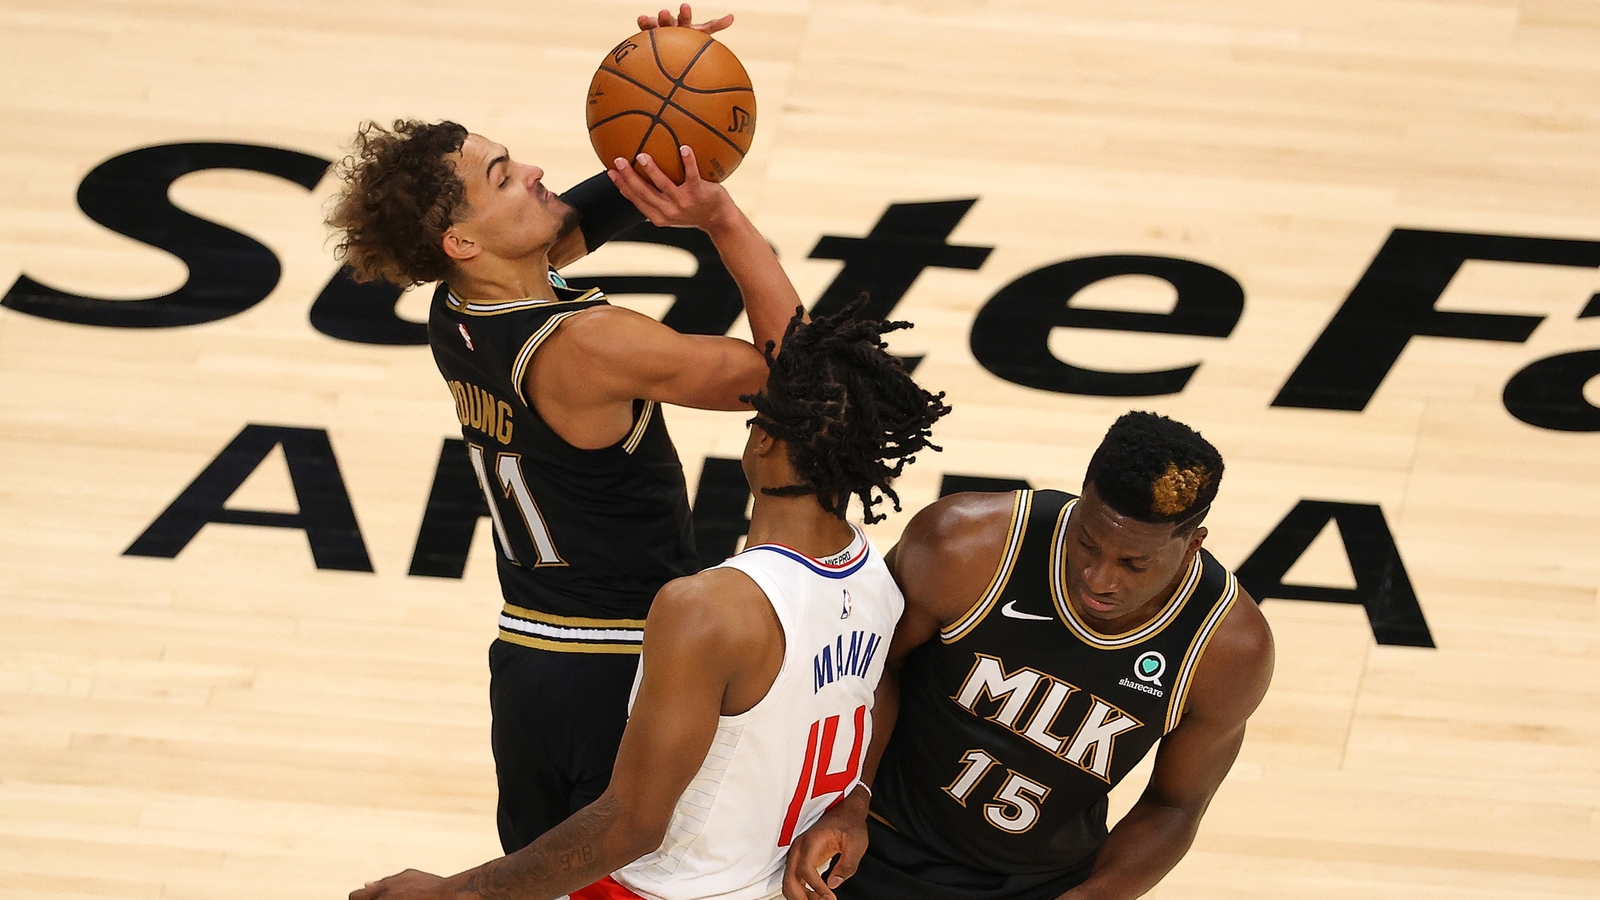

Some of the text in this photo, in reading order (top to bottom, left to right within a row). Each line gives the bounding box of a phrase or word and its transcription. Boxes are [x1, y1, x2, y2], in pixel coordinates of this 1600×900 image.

[814, 631, 882, 695] MANN
[1118, 677, 1164, 698] sharecare
[949, 652, 1145, 784] MLK
[777, 704, 866, 848] 14
[940, 749, 1052, 834] 15
